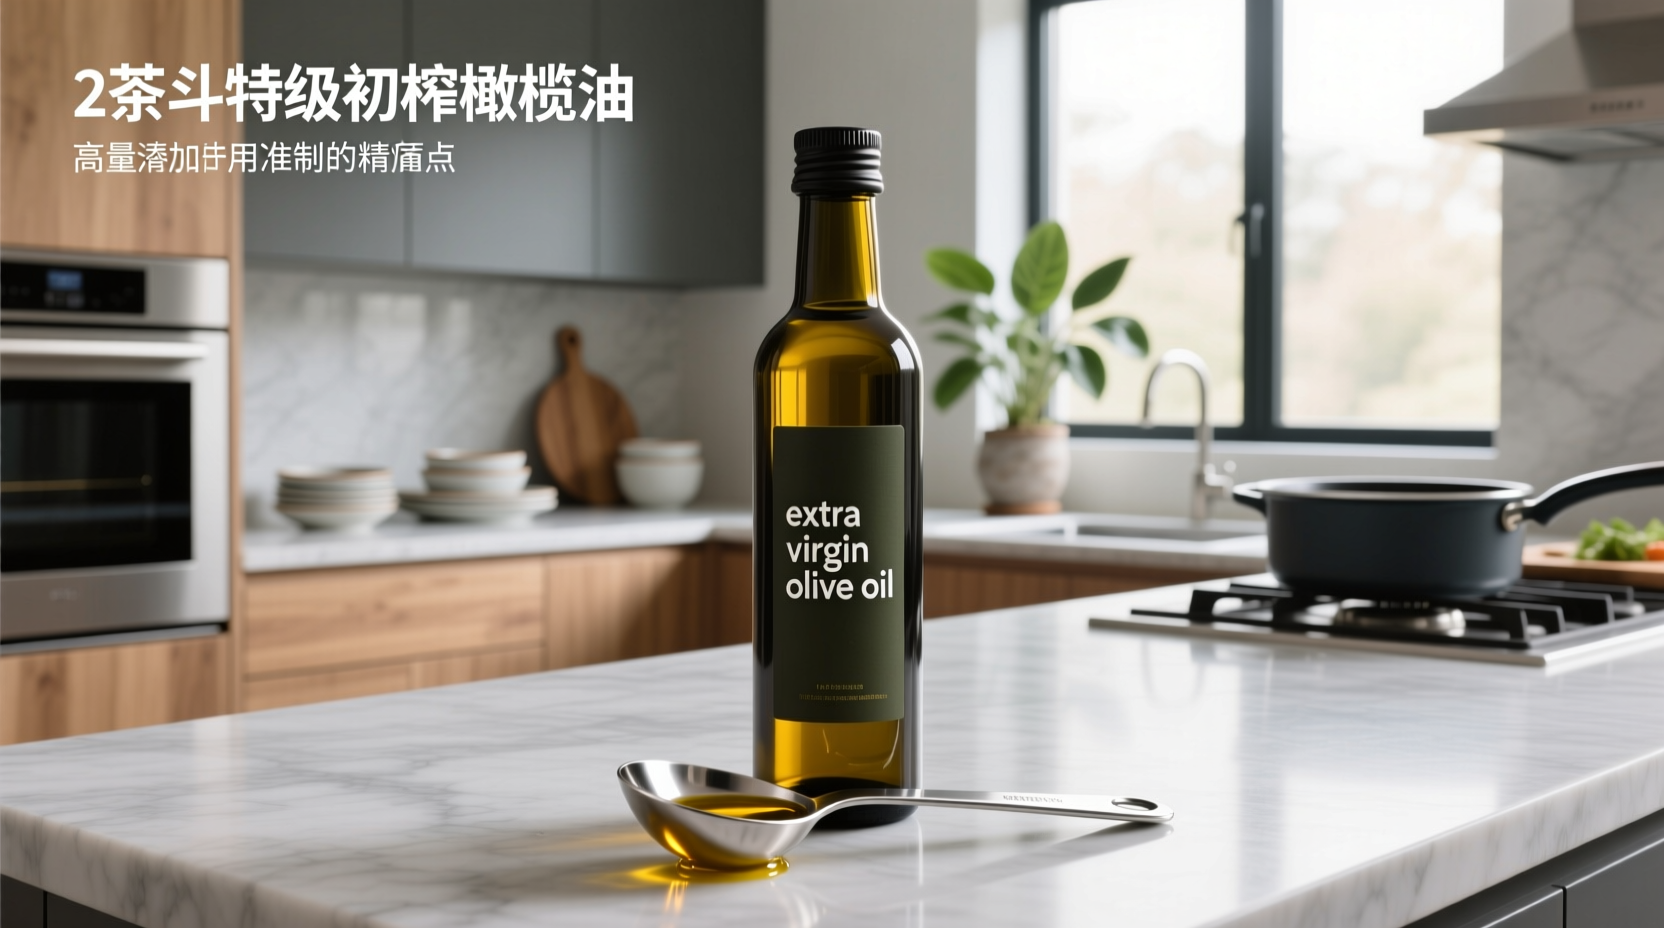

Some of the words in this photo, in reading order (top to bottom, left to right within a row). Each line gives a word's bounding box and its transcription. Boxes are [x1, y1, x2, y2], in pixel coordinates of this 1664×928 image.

[786, 501, 861, 527] extra
[786, 534, 869, 573] virgin
[786, 569, 854, 600] olive
[861, 568, 894, 599] oil
